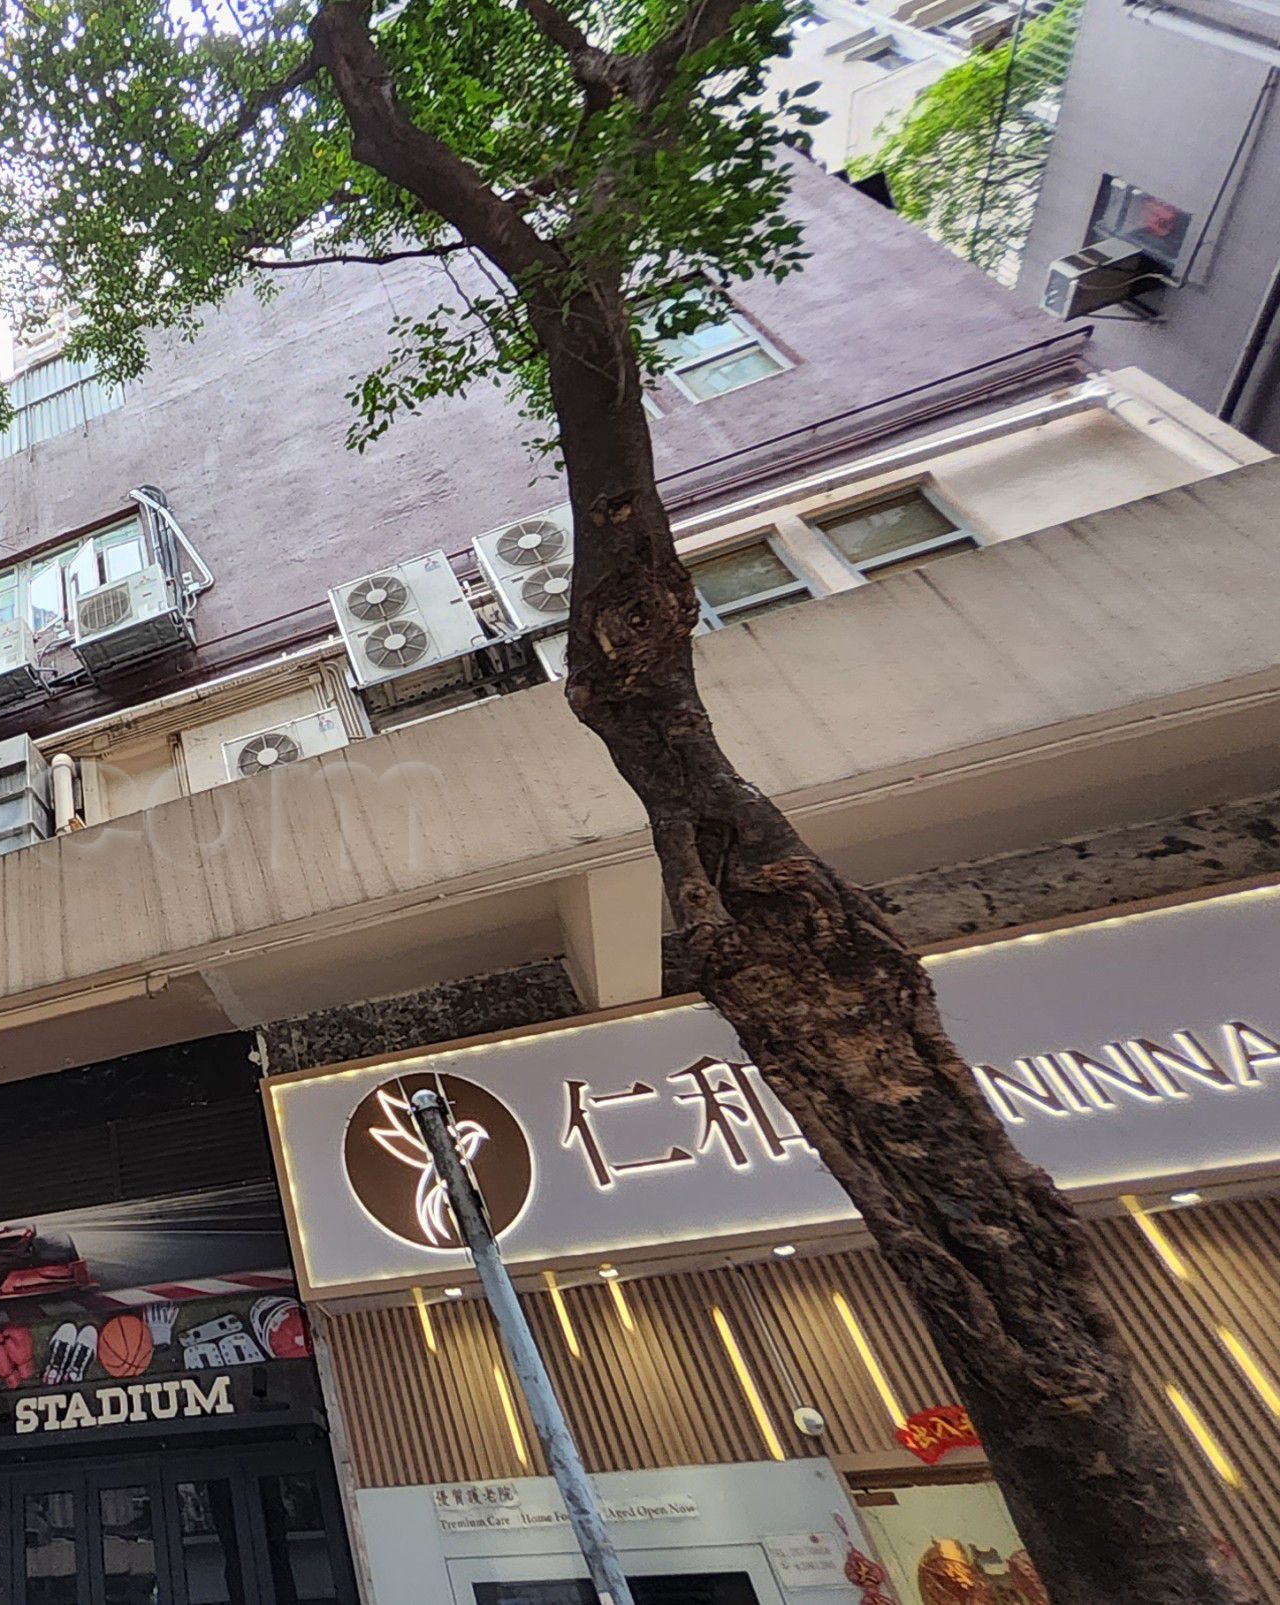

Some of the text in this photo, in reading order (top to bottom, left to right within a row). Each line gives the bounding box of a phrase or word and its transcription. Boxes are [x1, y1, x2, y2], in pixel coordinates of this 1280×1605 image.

[972, 1020, 1280, 1125] NINNA
[560, 1055, 818, 1191] 仁和
[14, 1376, 235, 1434] STADIUM
[487, 1515, 510, 1526] Care
[637, 1505, 667, 1520] Open
